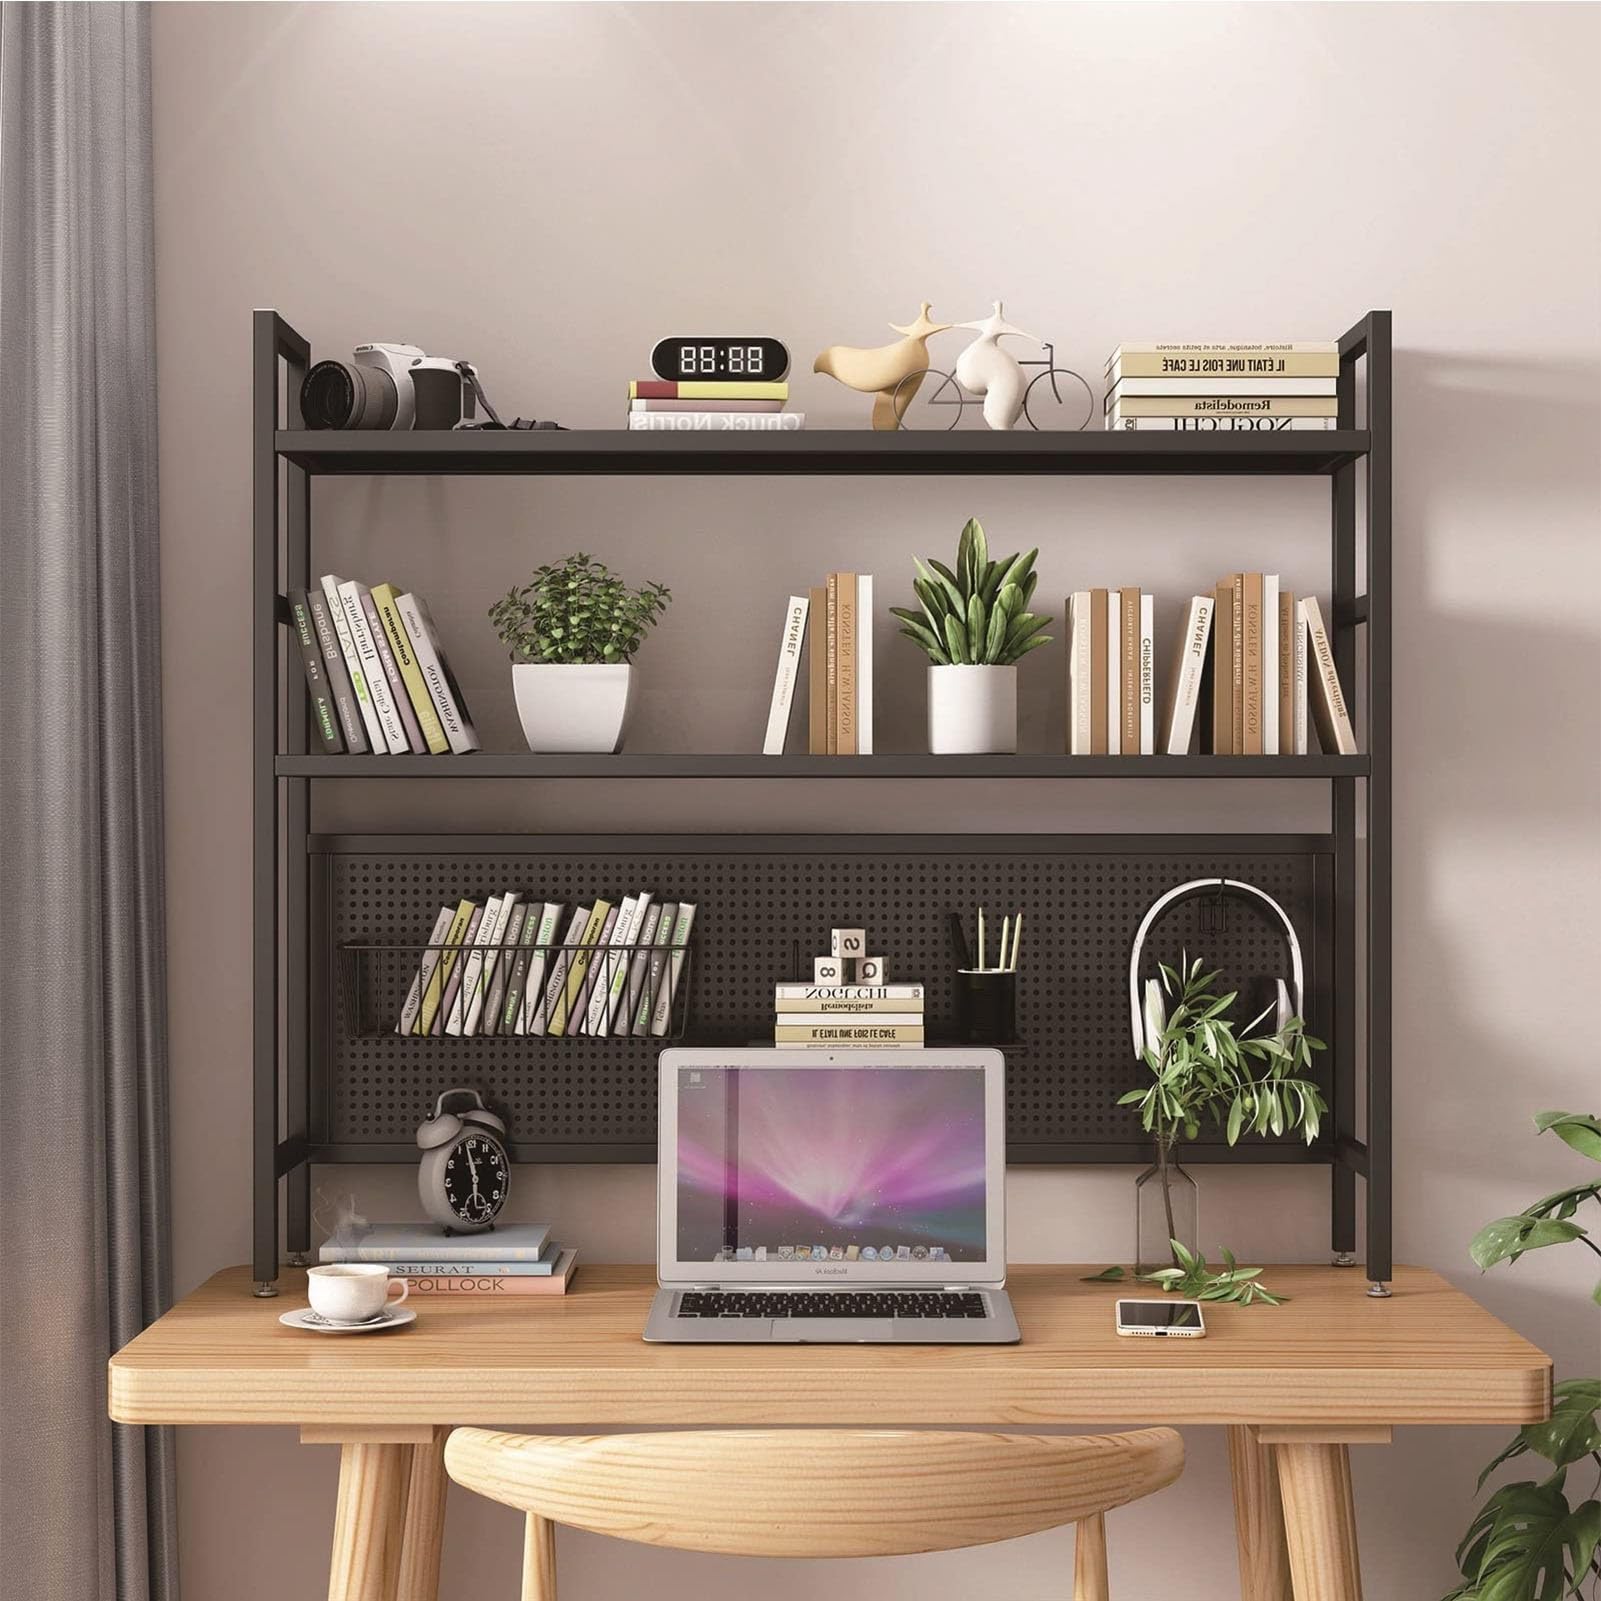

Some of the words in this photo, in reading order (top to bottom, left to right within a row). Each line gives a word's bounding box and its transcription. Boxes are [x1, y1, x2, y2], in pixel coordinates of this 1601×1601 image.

[681, 346, 763, 373] 88:88
[395, 1265, 475, 1275] SEURAT
[407, 1278, 505, 1292] POLLOCK
